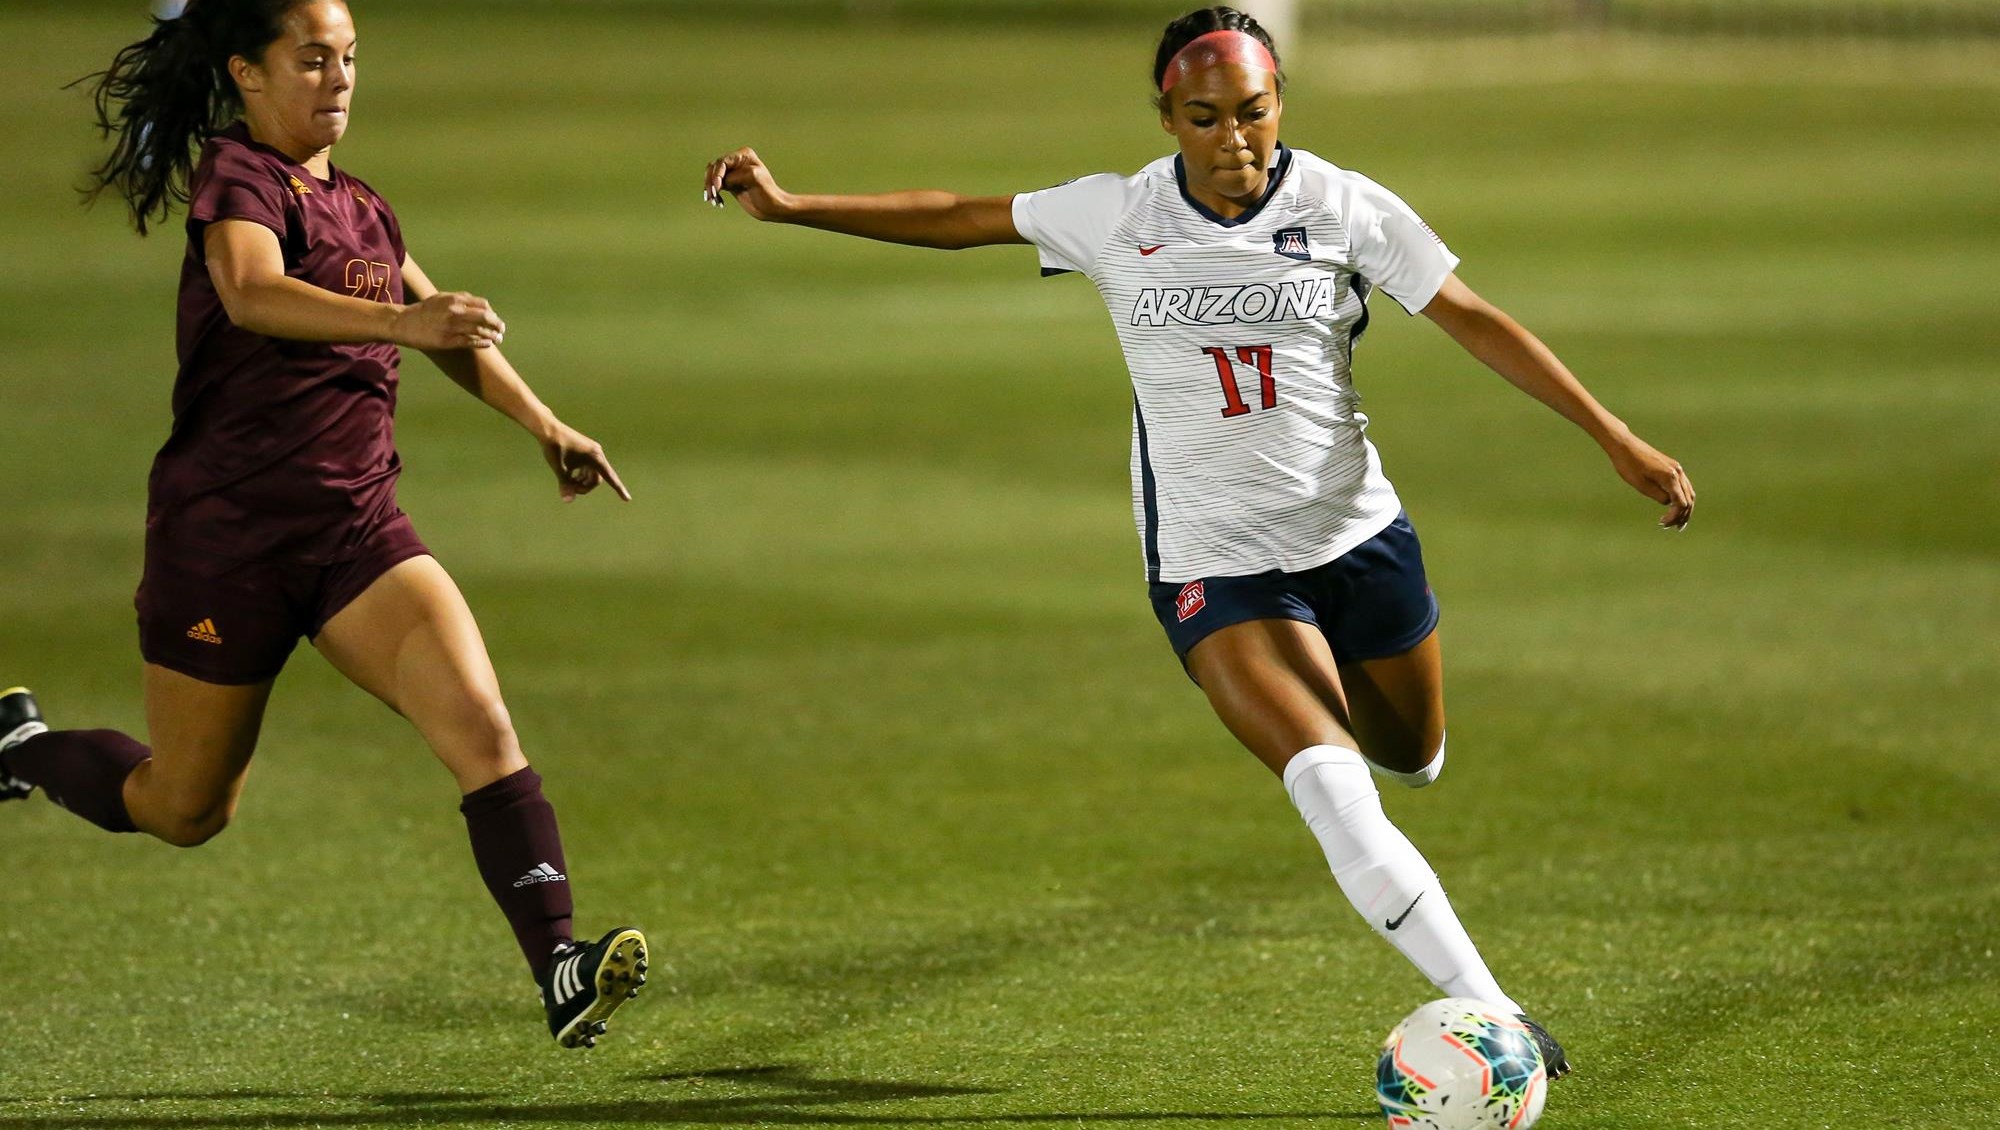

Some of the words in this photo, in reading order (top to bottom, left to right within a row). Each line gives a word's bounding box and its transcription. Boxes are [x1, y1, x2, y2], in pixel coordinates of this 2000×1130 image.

[1131, 277, 1337, 326] ARIZONA
[1202, 344, 1277, 418] 17
[513, 873, 566, 888] adidas
